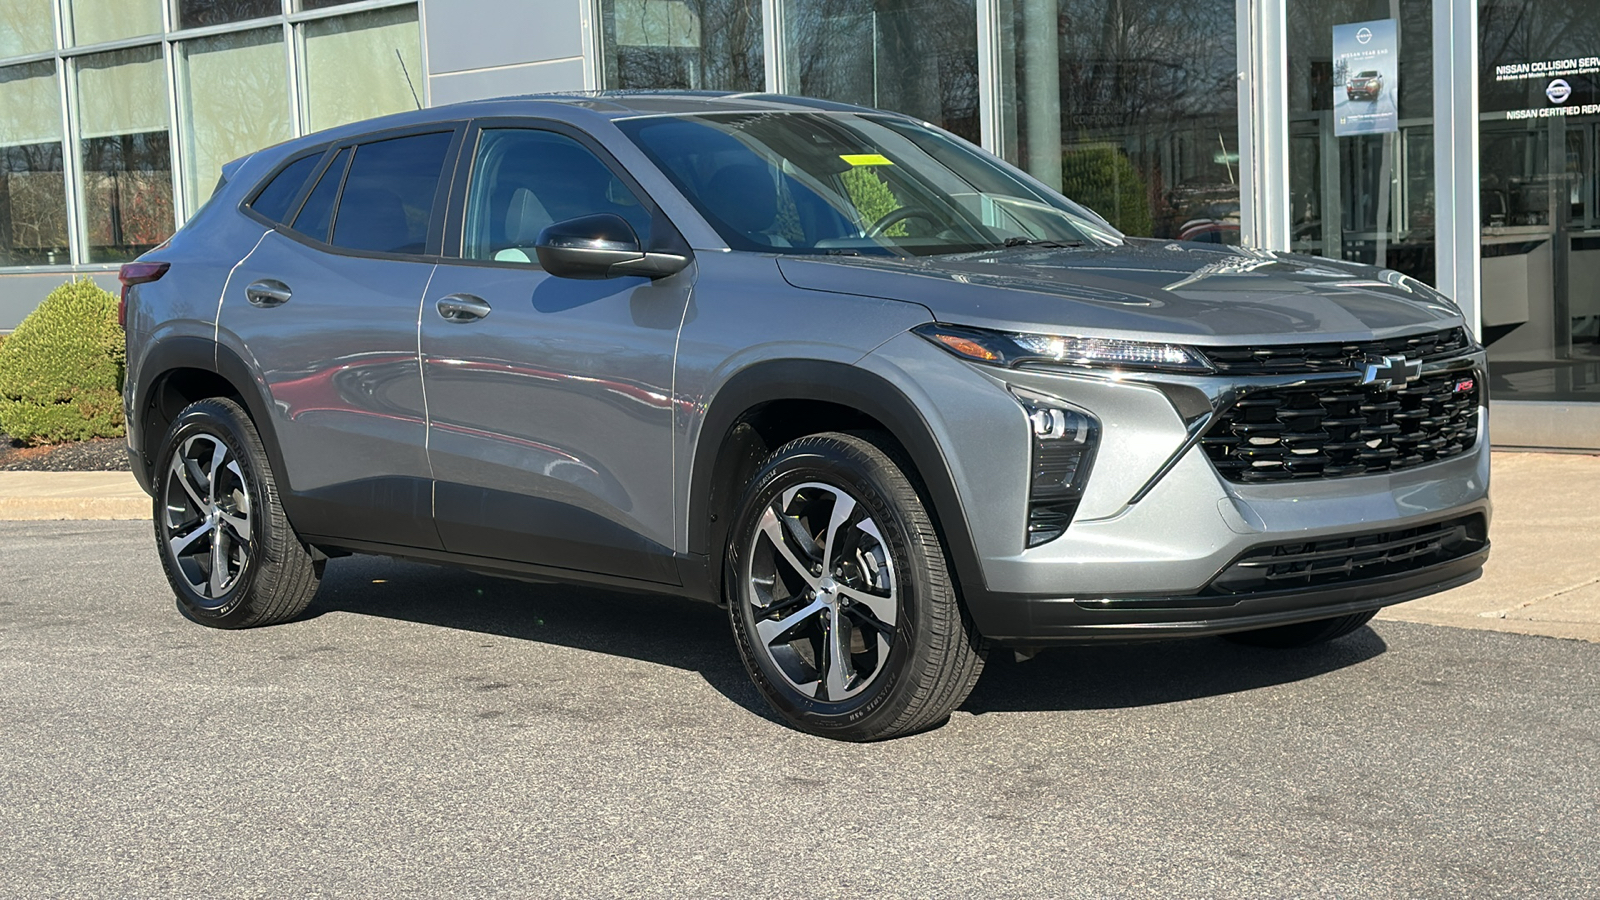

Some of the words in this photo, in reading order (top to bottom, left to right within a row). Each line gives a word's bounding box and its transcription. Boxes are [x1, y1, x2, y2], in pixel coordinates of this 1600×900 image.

[1496, 63, 1530, 74] NISSAN
[1531, 59, 1577, 71] COLLISION
[1507, 109, 1537, 120] NISSAN
[1539, 106, 1580, 117] CERTIFIED
[1457, 380, 1473, 391] RS
